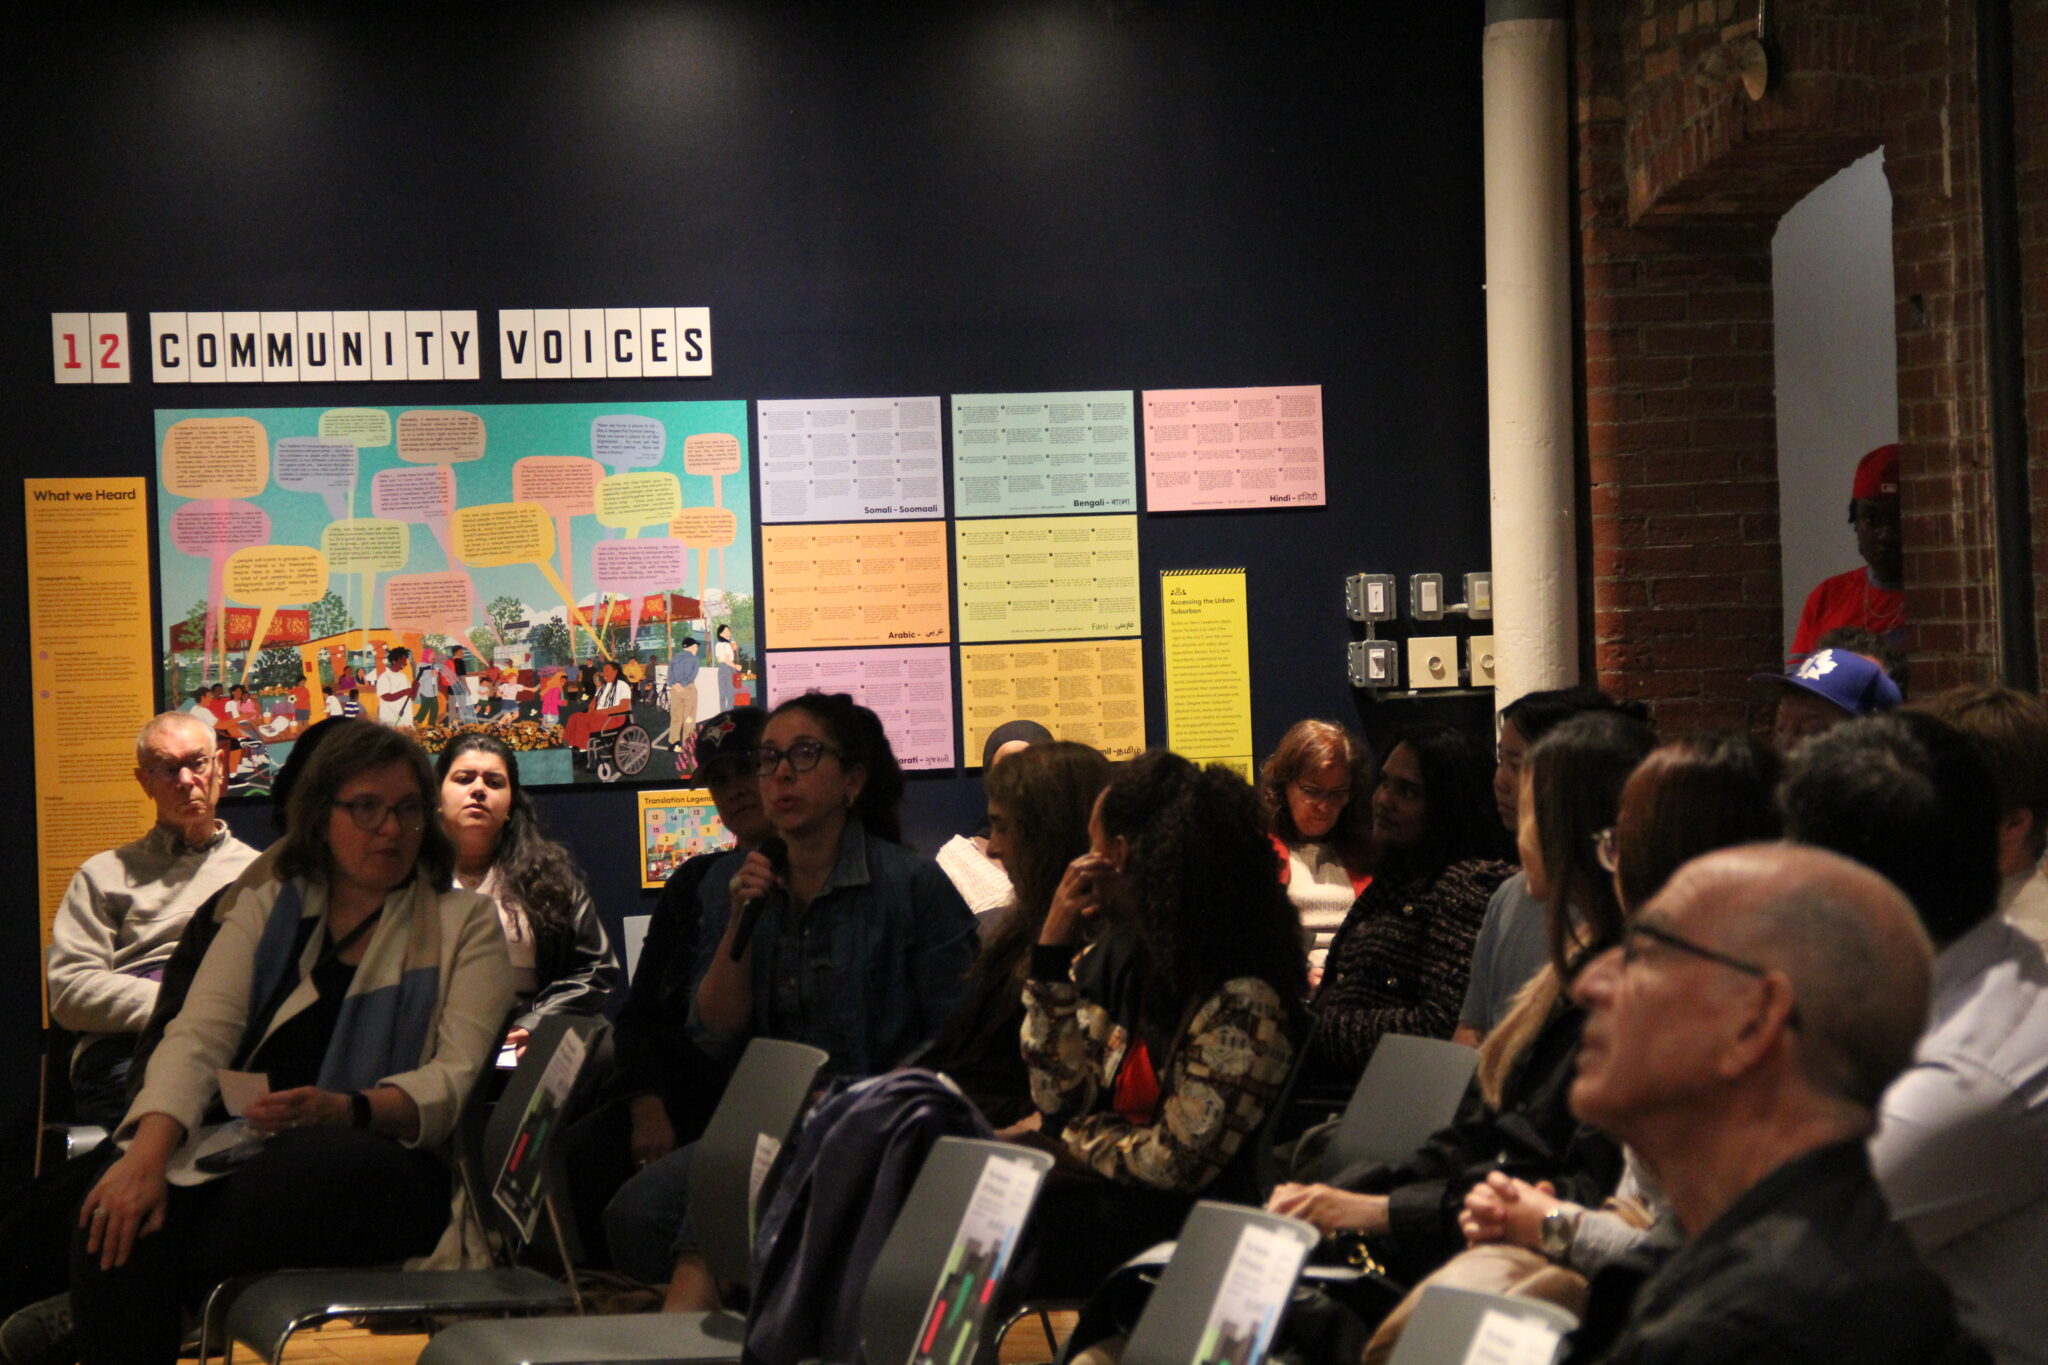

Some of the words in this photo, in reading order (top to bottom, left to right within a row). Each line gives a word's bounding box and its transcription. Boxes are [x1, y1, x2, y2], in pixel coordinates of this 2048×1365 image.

[63, 334, 120, 368] 12
[160, 332, 470, 368] COMMUNITY
[506, 328, 703, 364] VOICES
[34, 490, 70, 500] What
[73, 492, 92, 500] we
[95, 488, 136, 500] Heard
[899, 504, 938, 512] Soomaali
[1074, 499, 1104, 508] Bengali
